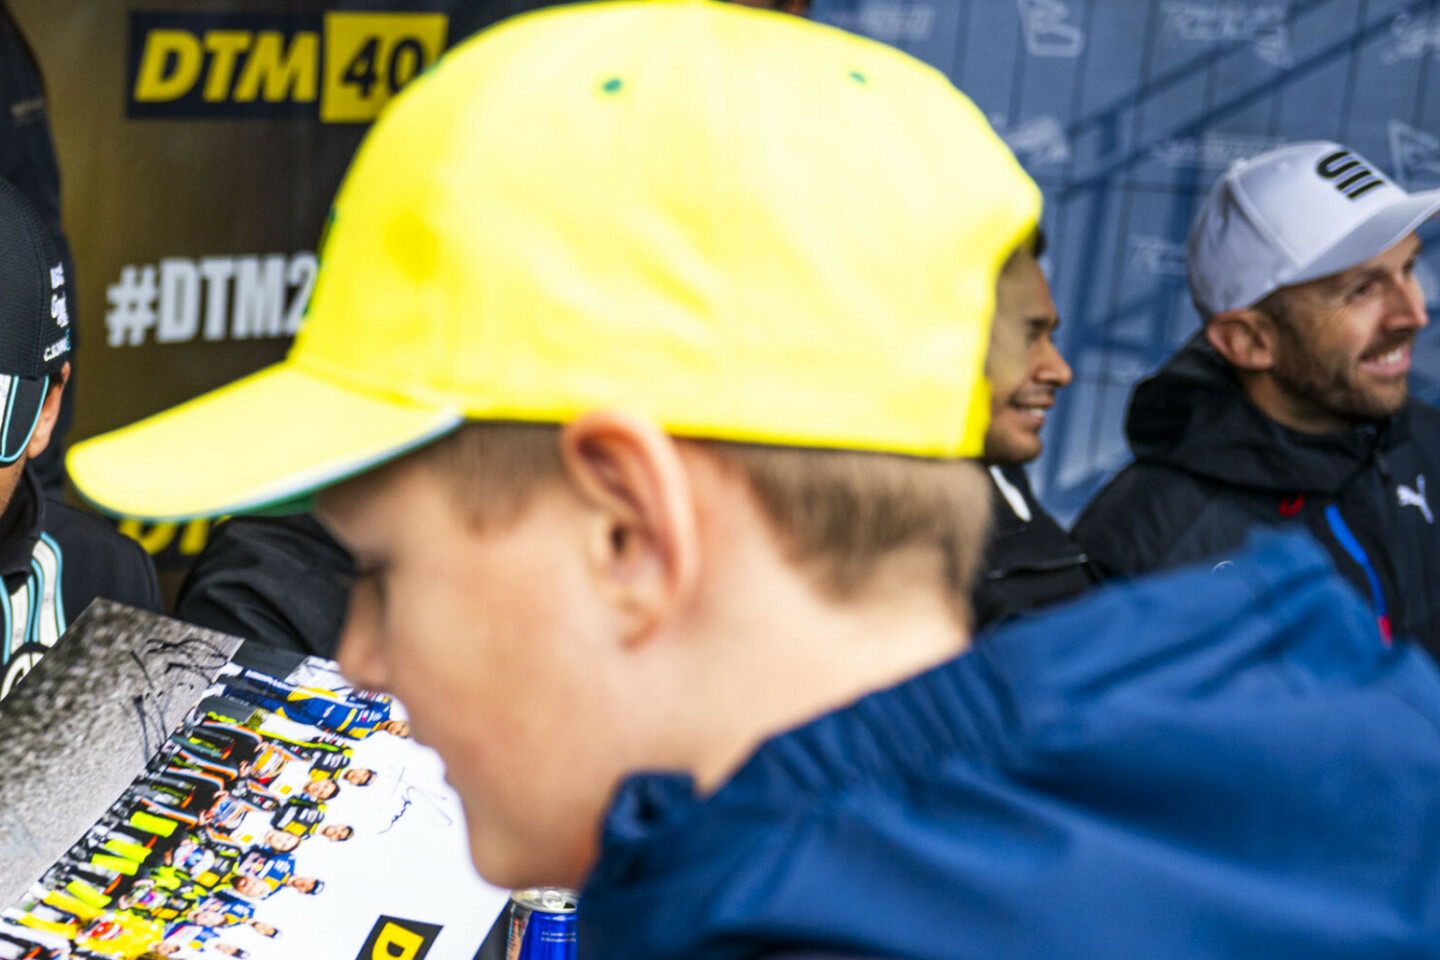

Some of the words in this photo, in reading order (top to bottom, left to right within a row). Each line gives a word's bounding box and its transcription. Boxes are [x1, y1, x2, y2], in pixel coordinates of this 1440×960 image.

[133, 28, 320, 102] DTM
[340, 34, 426, 101] 40
[105, 250, 317, 347] #DTM2
